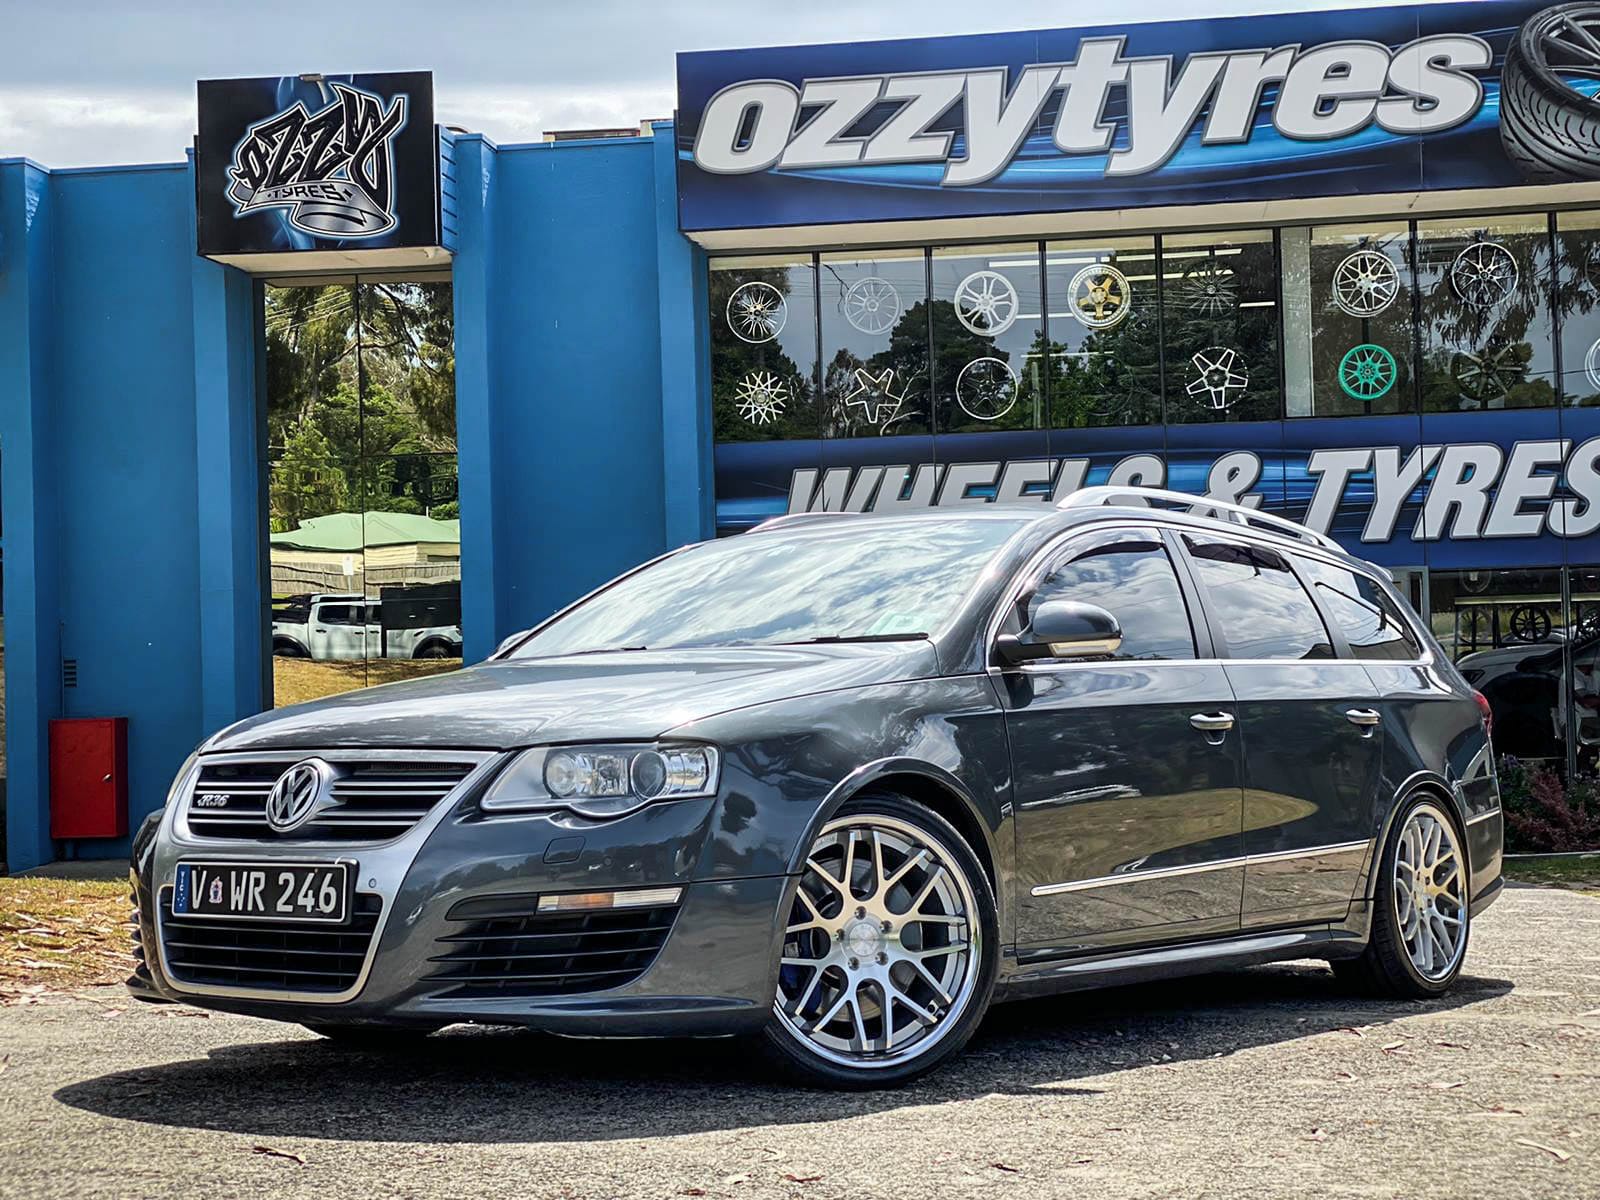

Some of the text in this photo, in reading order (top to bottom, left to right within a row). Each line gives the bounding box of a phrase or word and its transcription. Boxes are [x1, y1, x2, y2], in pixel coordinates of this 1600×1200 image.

[694, 34, 1493, 187] ozzytyres
[272, 184, 343, 201] TYRES
[1186, 451, 1262, 522] &
[1301, 436, 1600, 543] TYRES
[230, 871, 266, 911] WR
[276, 872, 337, 914] 246
